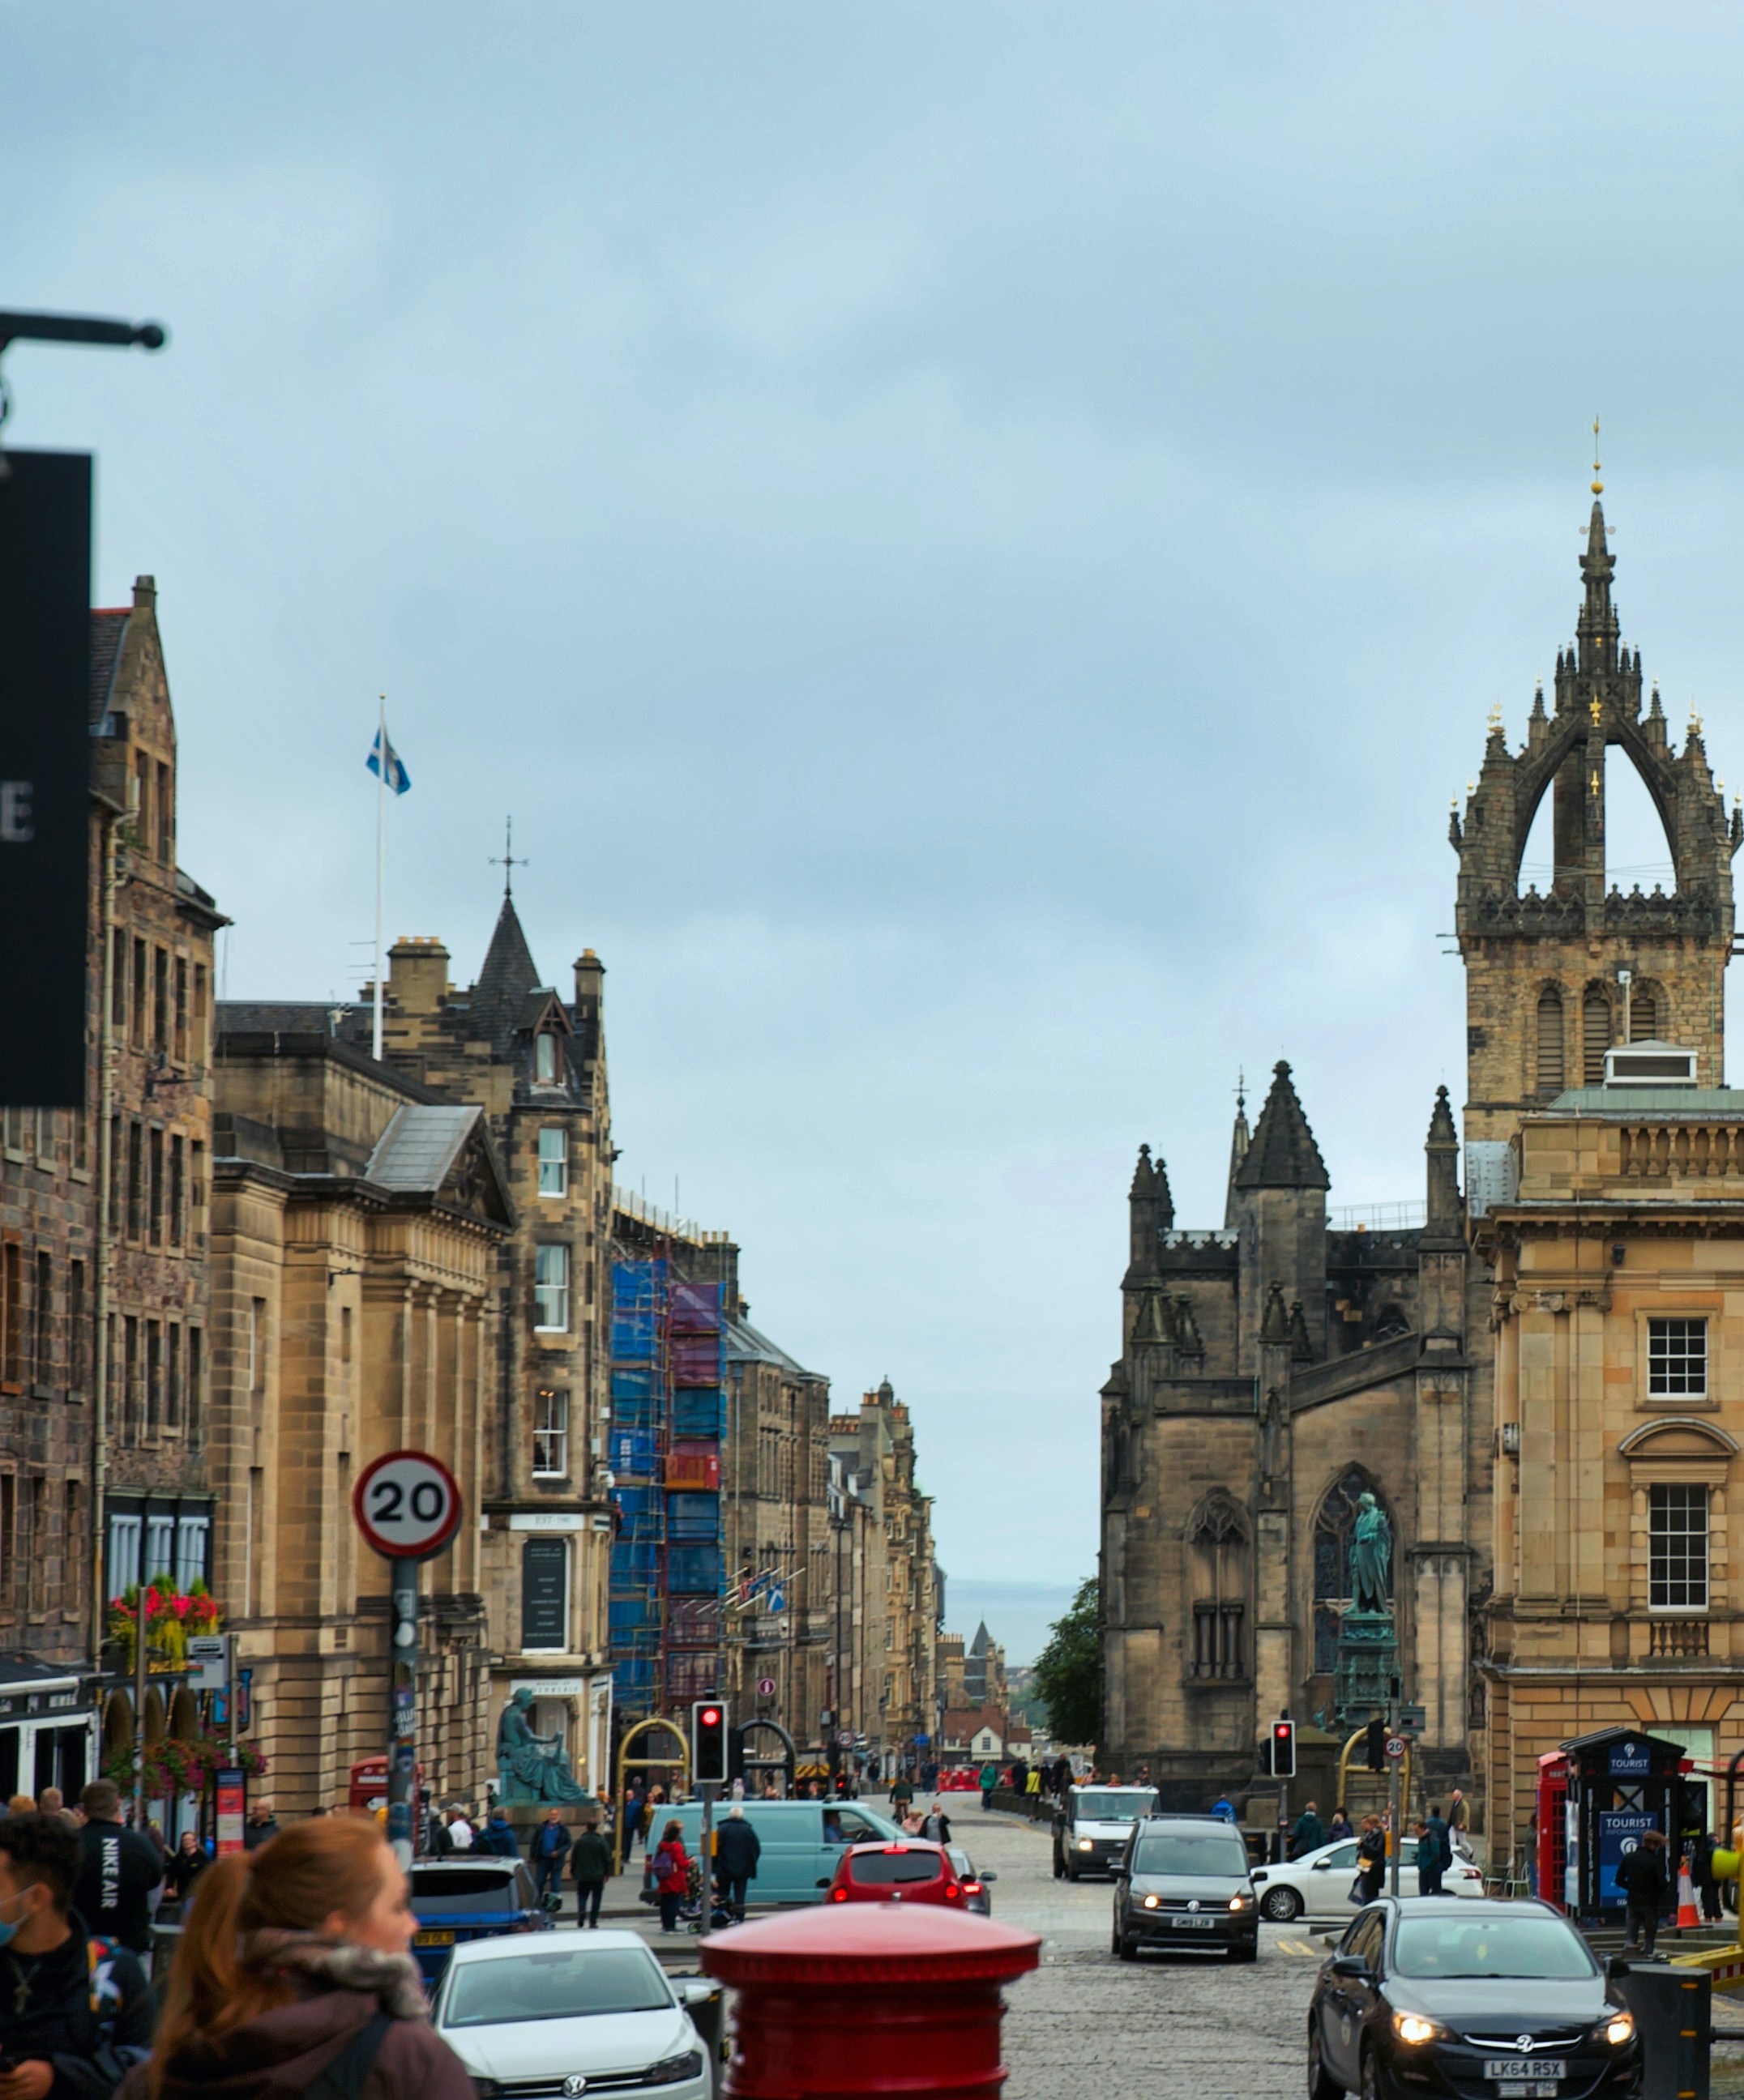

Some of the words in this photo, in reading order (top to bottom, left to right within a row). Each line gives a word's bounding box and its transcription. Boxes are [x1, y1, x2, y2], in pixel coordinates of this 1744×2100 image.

[371, 1481, 444, 1522] 20
[1387, 1742, 1403, 1752] 20
[1610, 1759, 1648, 1768] TOURIST
[1605, 1817, 1652, 1829] TOURIST
[101, 1838, 119, 1876] NIKE
[100, 1879, 119, 1909] AIR
[1491, 2062, 1528, 2077] LK64
[1532, 2062, 1560, 2077] RSX
